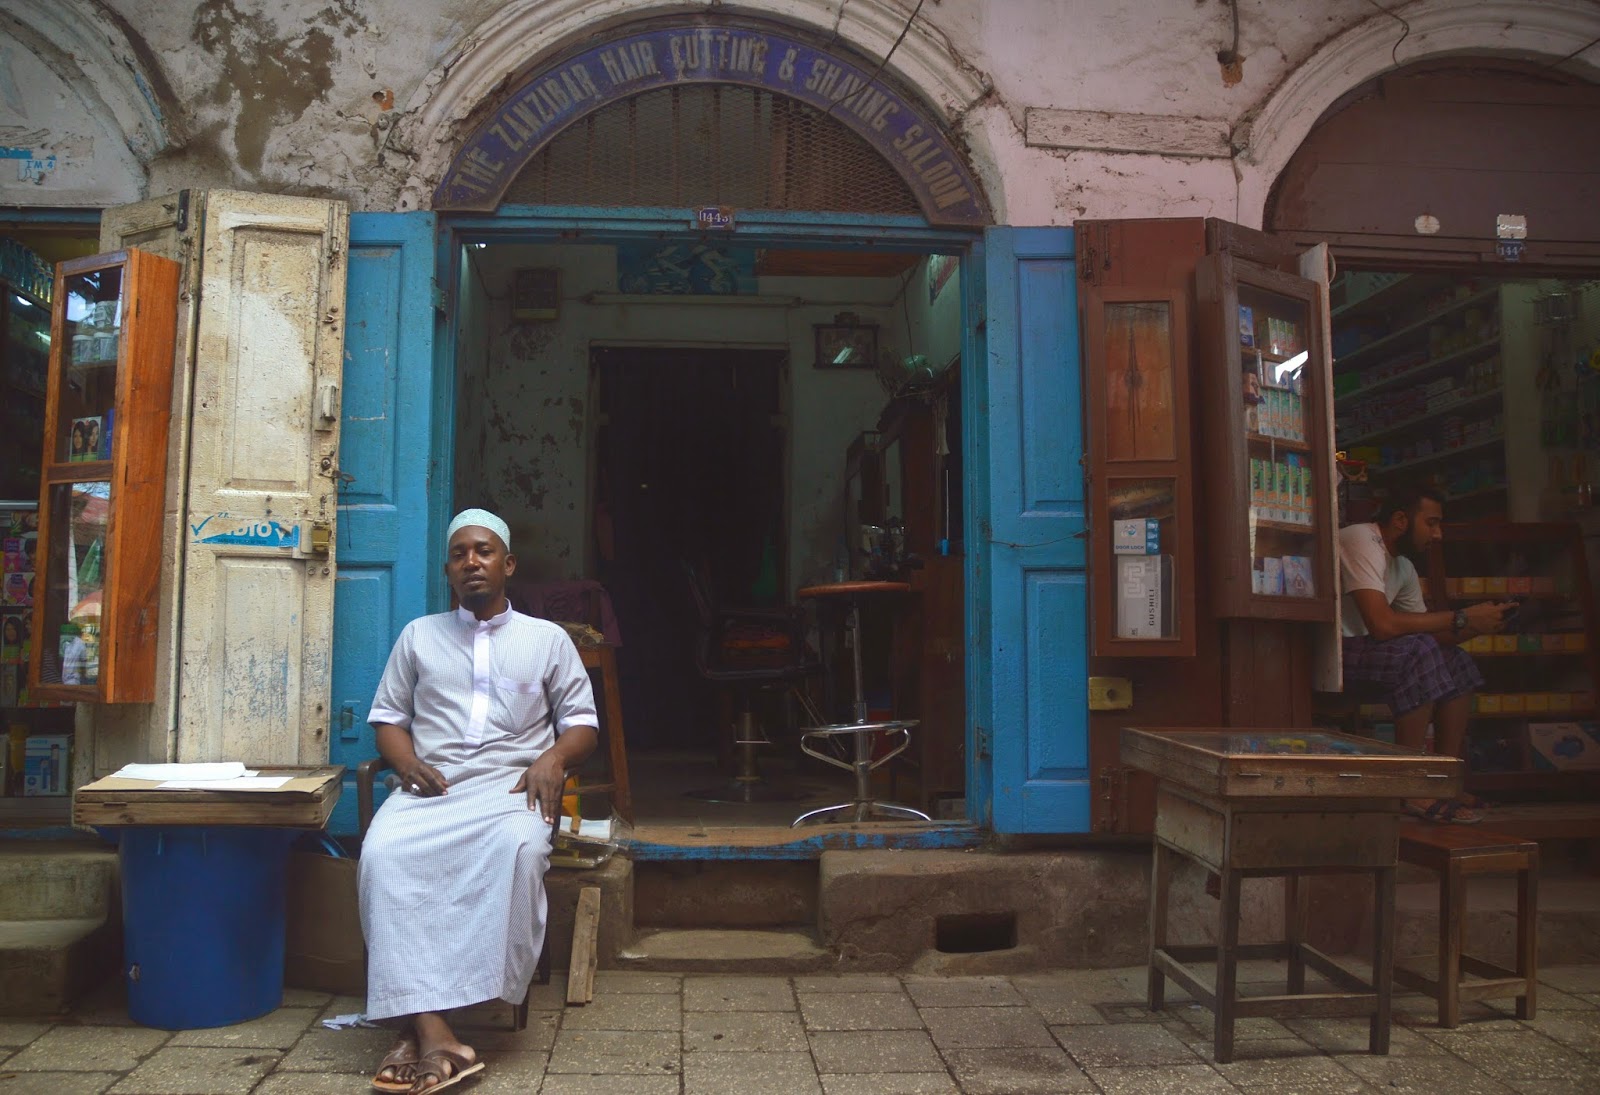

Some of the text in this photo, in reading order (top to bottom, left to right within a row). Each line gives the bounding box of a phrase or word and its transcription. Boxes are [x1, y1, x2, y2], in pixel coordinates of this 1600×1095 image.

[451, 29, 971, 210] THE ZANZIBAR HAIR CUTTING & SHAVING SALOON
